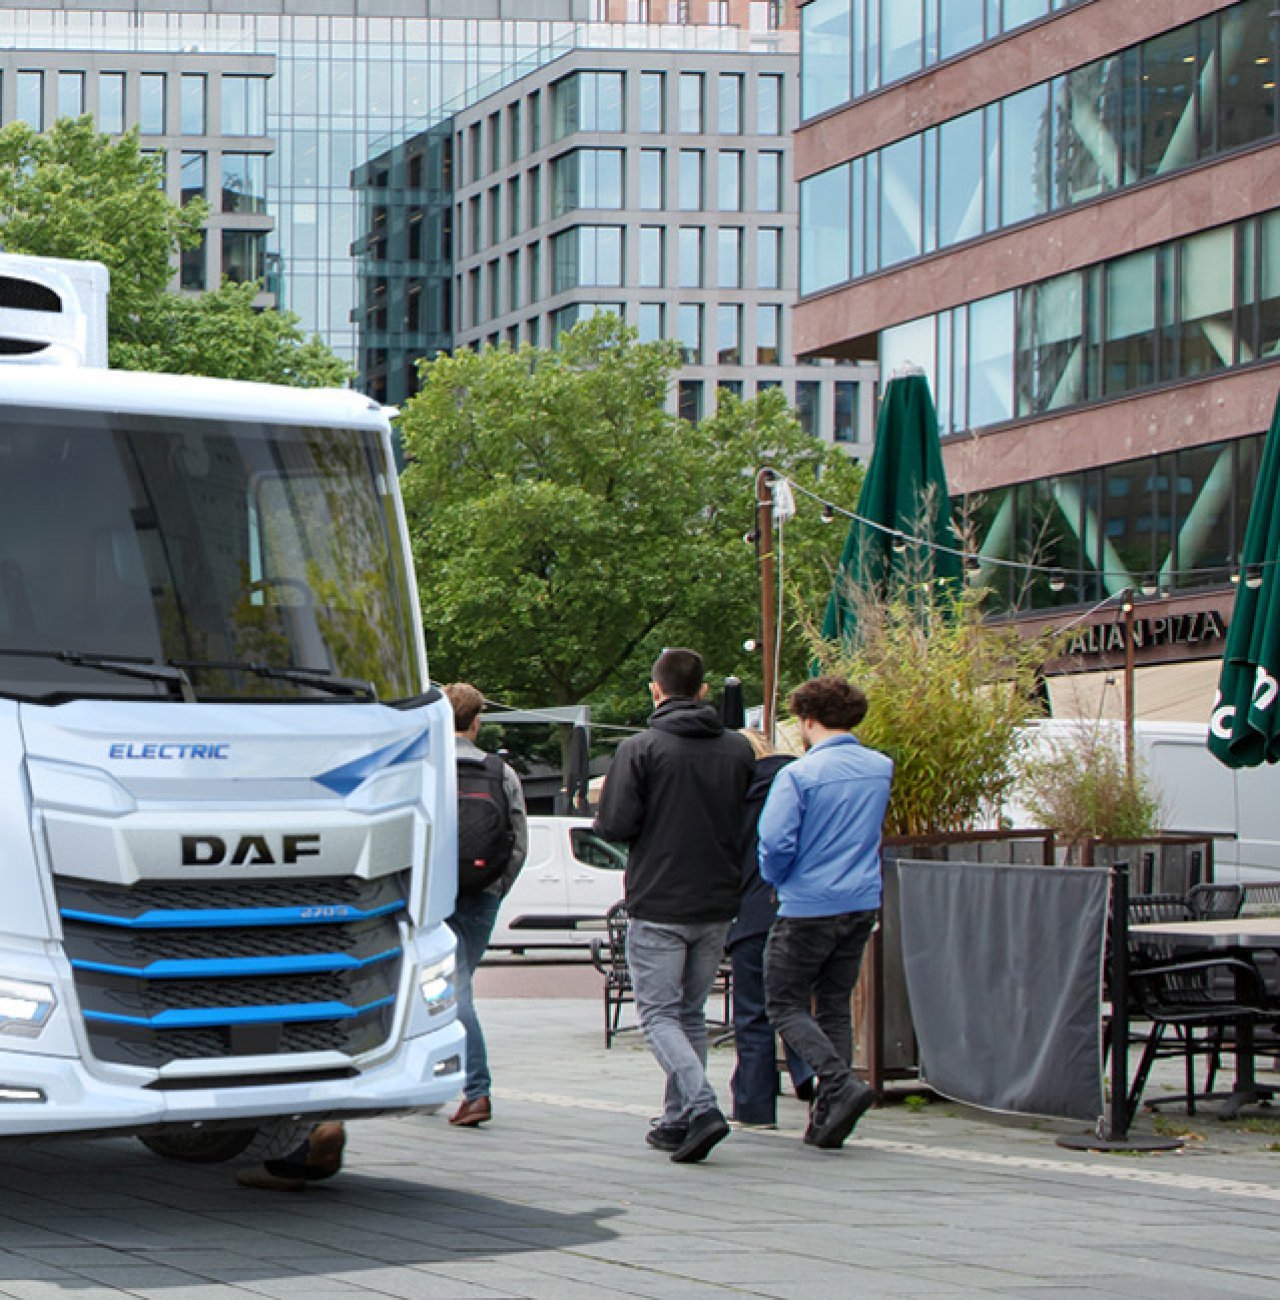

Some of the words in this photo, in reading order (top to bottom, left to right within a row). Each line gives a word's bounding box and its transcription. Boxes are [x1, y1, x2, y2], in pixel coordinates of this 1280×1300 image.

[1153, 611, 1222, 645] PIZZA
[109, 743, 230, 759] ELECTRIC
[181, 834, 320, 865] DAF
